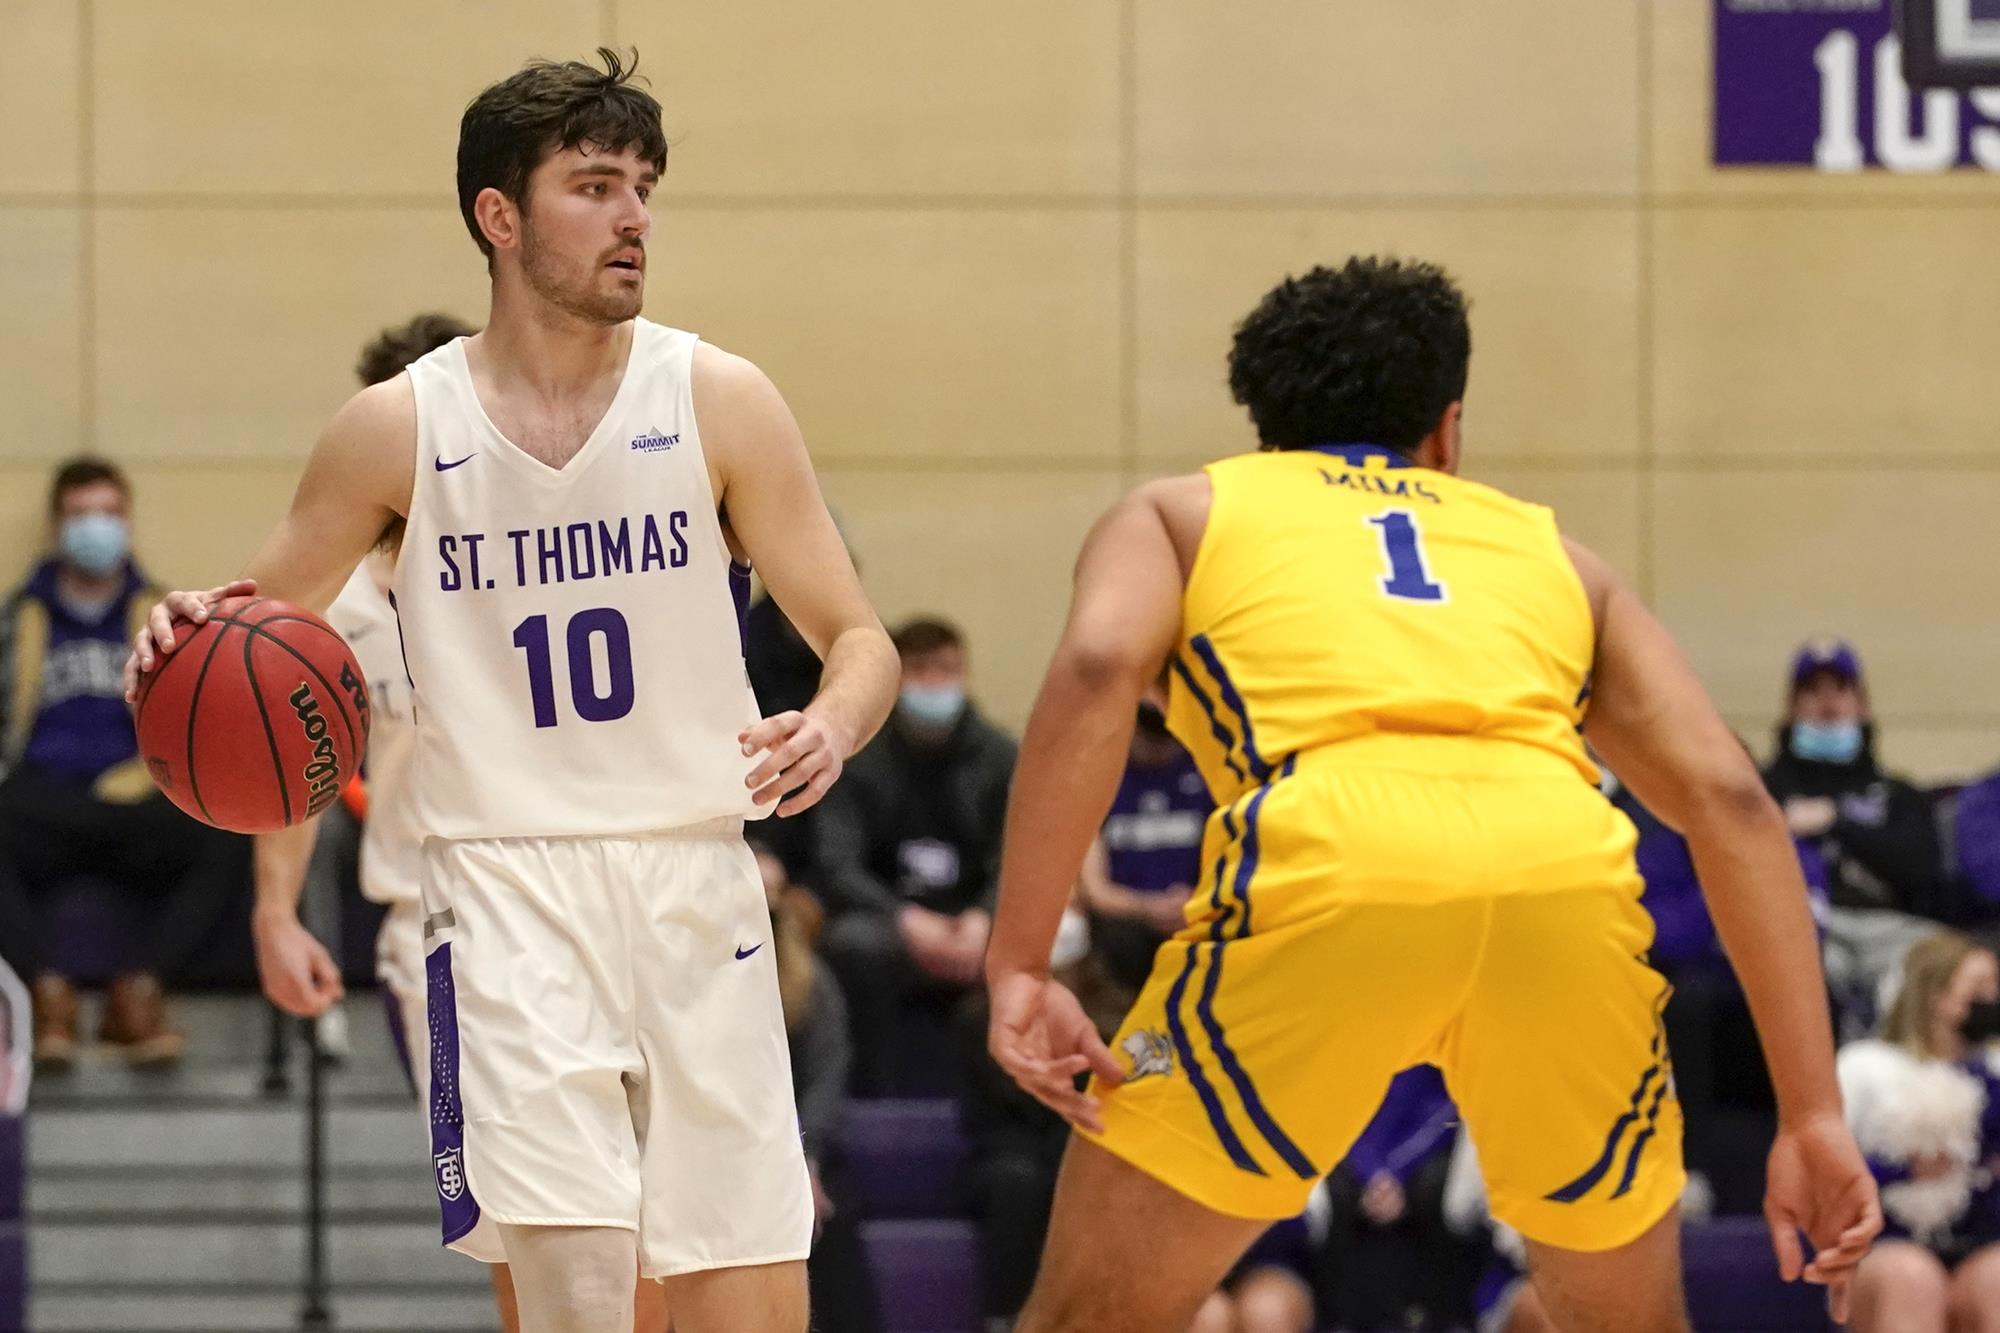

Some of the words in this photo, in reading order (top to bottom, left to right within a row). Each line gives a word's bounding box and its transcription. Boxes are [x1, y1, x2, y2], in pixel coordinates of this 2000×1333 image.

[631, 433, 680, 450] SUMMIT
[1317, 466, 1442, 504] MIMS
[438, 533, 496, 592] ST.
[507, 510, 689, 588] THOMAS
[1365, 508, 1447, 604] 1
[512, 607, 635, 729] 10
[288, 680, 341, 821] Wilson
